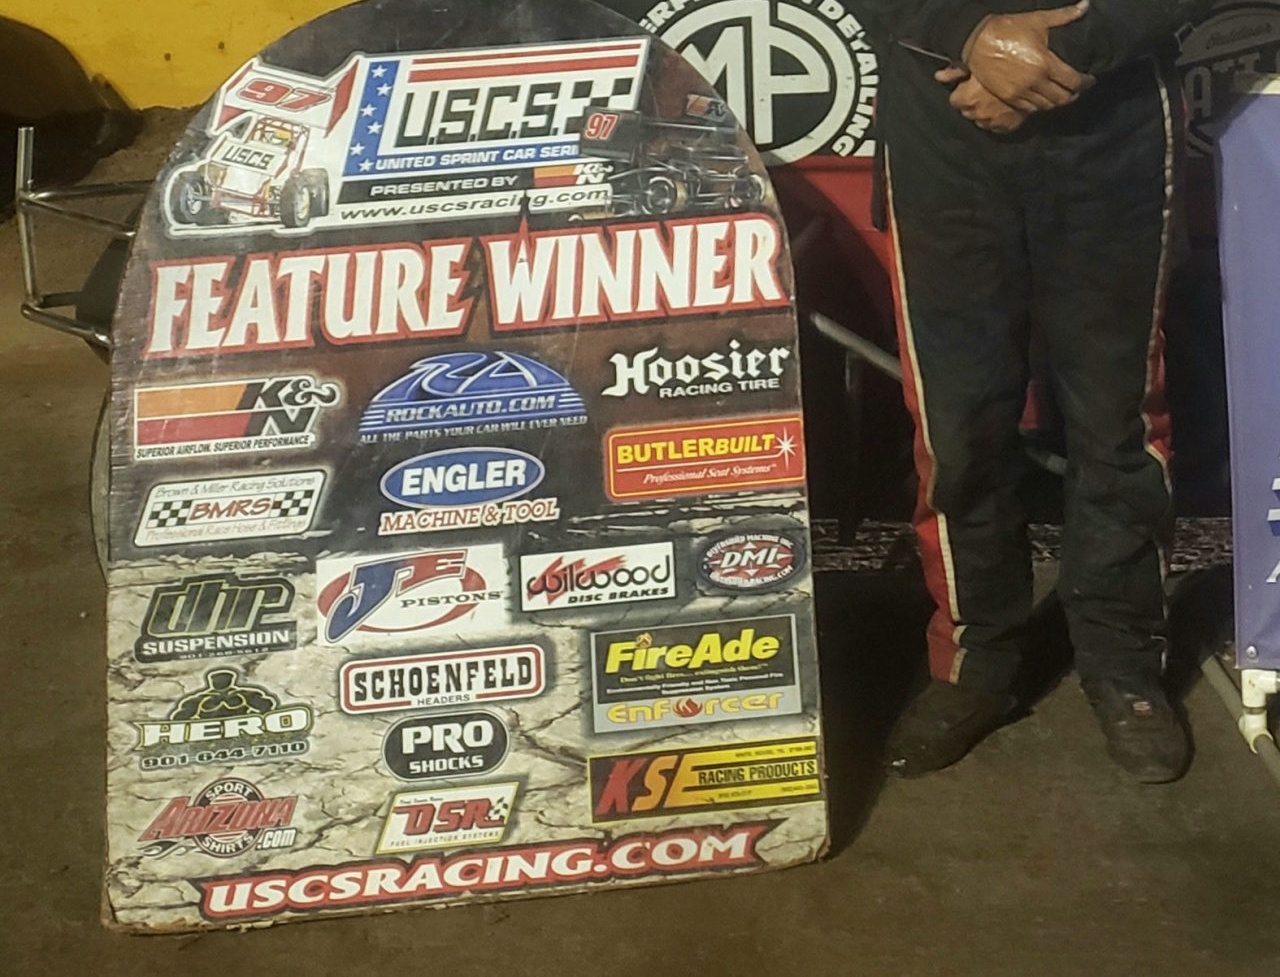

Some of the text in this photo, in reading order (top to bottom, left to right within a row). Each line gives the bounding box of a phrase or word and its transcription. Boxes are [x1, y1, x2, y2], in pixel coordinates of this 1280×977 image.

[237, 78, 332, 112] 97
[584, 112, 619, 140] 97
[221, 145, 275, 170] USCS
[375, 154, 437, 171] UNITED
[440, 149, 500, 167] SPRINT
[502, 146, 538, 162] CAR
[370, 178, 489, 198] PRESENTED
[491, 175, 519, 188] BY
[340, 188, 609, 220] www.uscsracig.com
[149, 219, 784, 352] FEATURE WINNER
[601, 339, 791, 397] Hoosier
[659, 378, 780, 399] RACING TIRE
[234, 377, 340, 438] K&N
[384, 394, 556, 424] ROCKAUTO.COM
[360, 415, 588, 444] ALL THE PARTS YOUR CAR WILL EVER NEED
[136, 445, 176, 459] SUPERIOR
[213, 439, 251, 452] SUPERIOR
[253, 435, 309, 450] PERFORMANCE
[617, 434, 776, 465] BUTLERBUILT
[401, 459, 527, 496] ENGLER
[189, 498, 271, 521] BMRS
[381, 501, 558, 532] MACHINE & TOOL
[720, 548, 778, 568] DMI
[401, 591, 502, 608] PISTONS
[568, 587, 669, 604] DISC BRAKES
[142, 630, 290, 656] SUSPENSION
[605, 628, 780, 673] FireAde
[353, 654, 535, 702] SCHOENFELD
[417, 694, 470, 706] HEADERS
[138, 708, 310, 749] HERO
[402, 720, 494, 754] PRO
[409, 755, 484, 774] SHOCKS
[698, 760, 815, 785] RACING PRODUCTS
[205, 782, 254, 802] SPORT
[595, 753, 718, 814] KSE
[393, 798, 506, 836] DSR
[202, 835, 254, 854] SHIRTS
[209, 832, 749, 914] USCSRACING.COM
